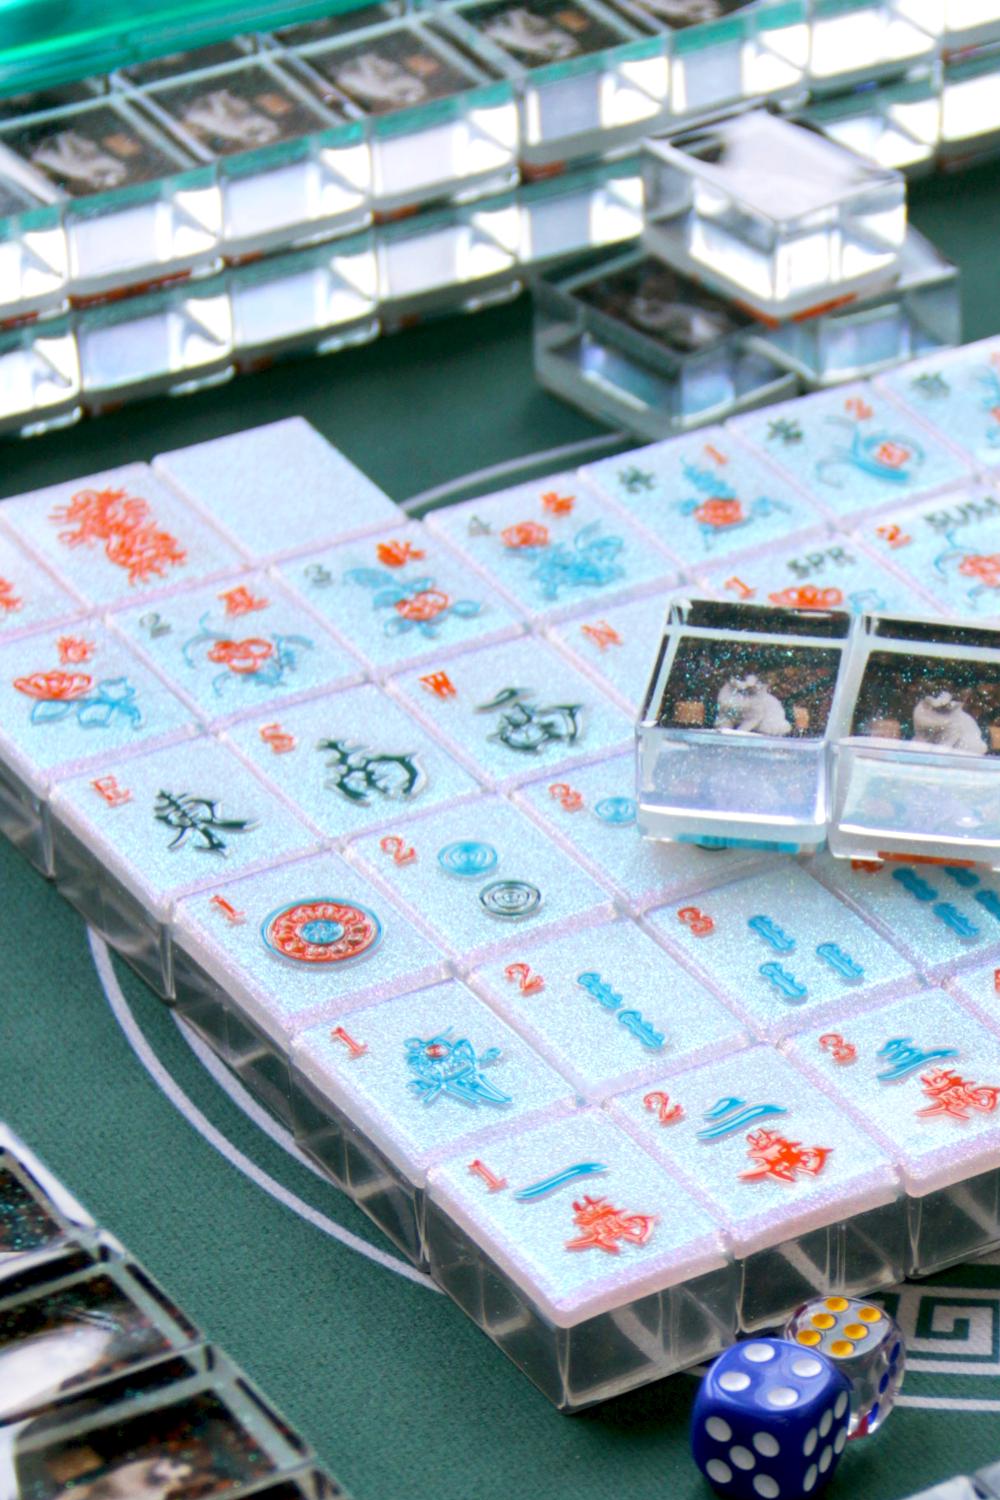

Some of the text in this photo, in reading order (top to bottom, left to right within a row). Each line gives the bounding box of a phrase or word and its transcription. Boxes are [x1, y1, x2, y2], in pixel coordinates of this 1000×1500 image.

[421, 672, 455, 698] W
[260, 724, 294, 753] S
[318, 740, 417, 806] 南
[91, 775, 130, 806] E
[549, 783, 583, 811] 3
[154, 790, 250, 856] 東
[380, 835, 416, 865] 2
[211, 896, 243, 922] 1
[678, 907, 714, 935] 3
[506, 962, 544, 996] 2
[332, 1027, 367, 1057] 1
[819, 1033, 856, 1064] 3
[644, 1091, 683, 1125] 2
[469, 1159, 506, 1191] 1
